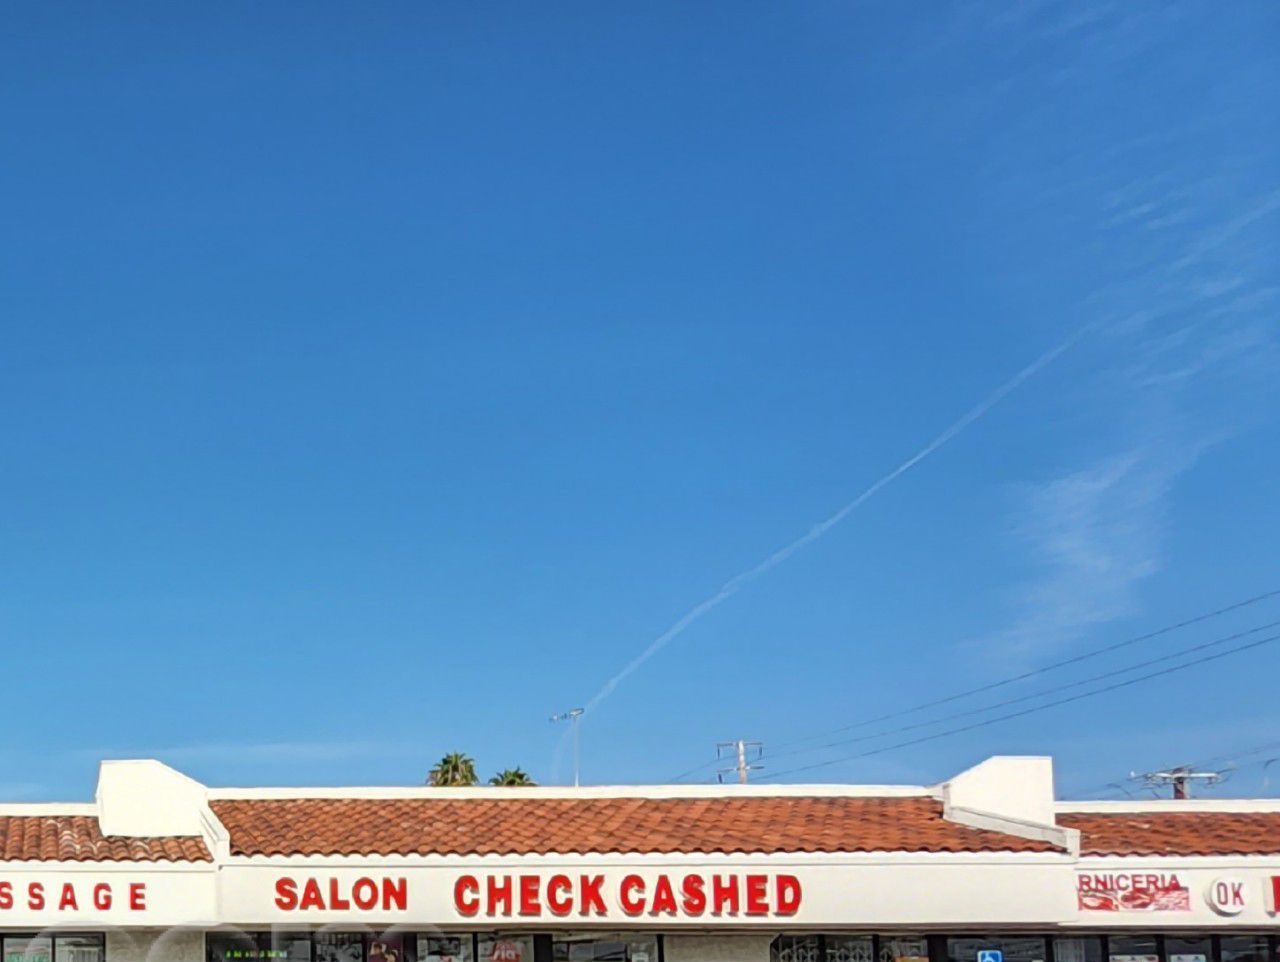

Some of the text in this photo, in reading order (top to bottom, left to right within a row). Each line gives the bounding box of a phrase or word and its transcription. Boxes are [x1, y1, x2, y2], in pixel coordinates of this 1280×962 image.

[274, 877, 408, 911] SALON
[453, 873, 802, 917] CHECK CASHED
[1217, 882, 1245, 906] OK
